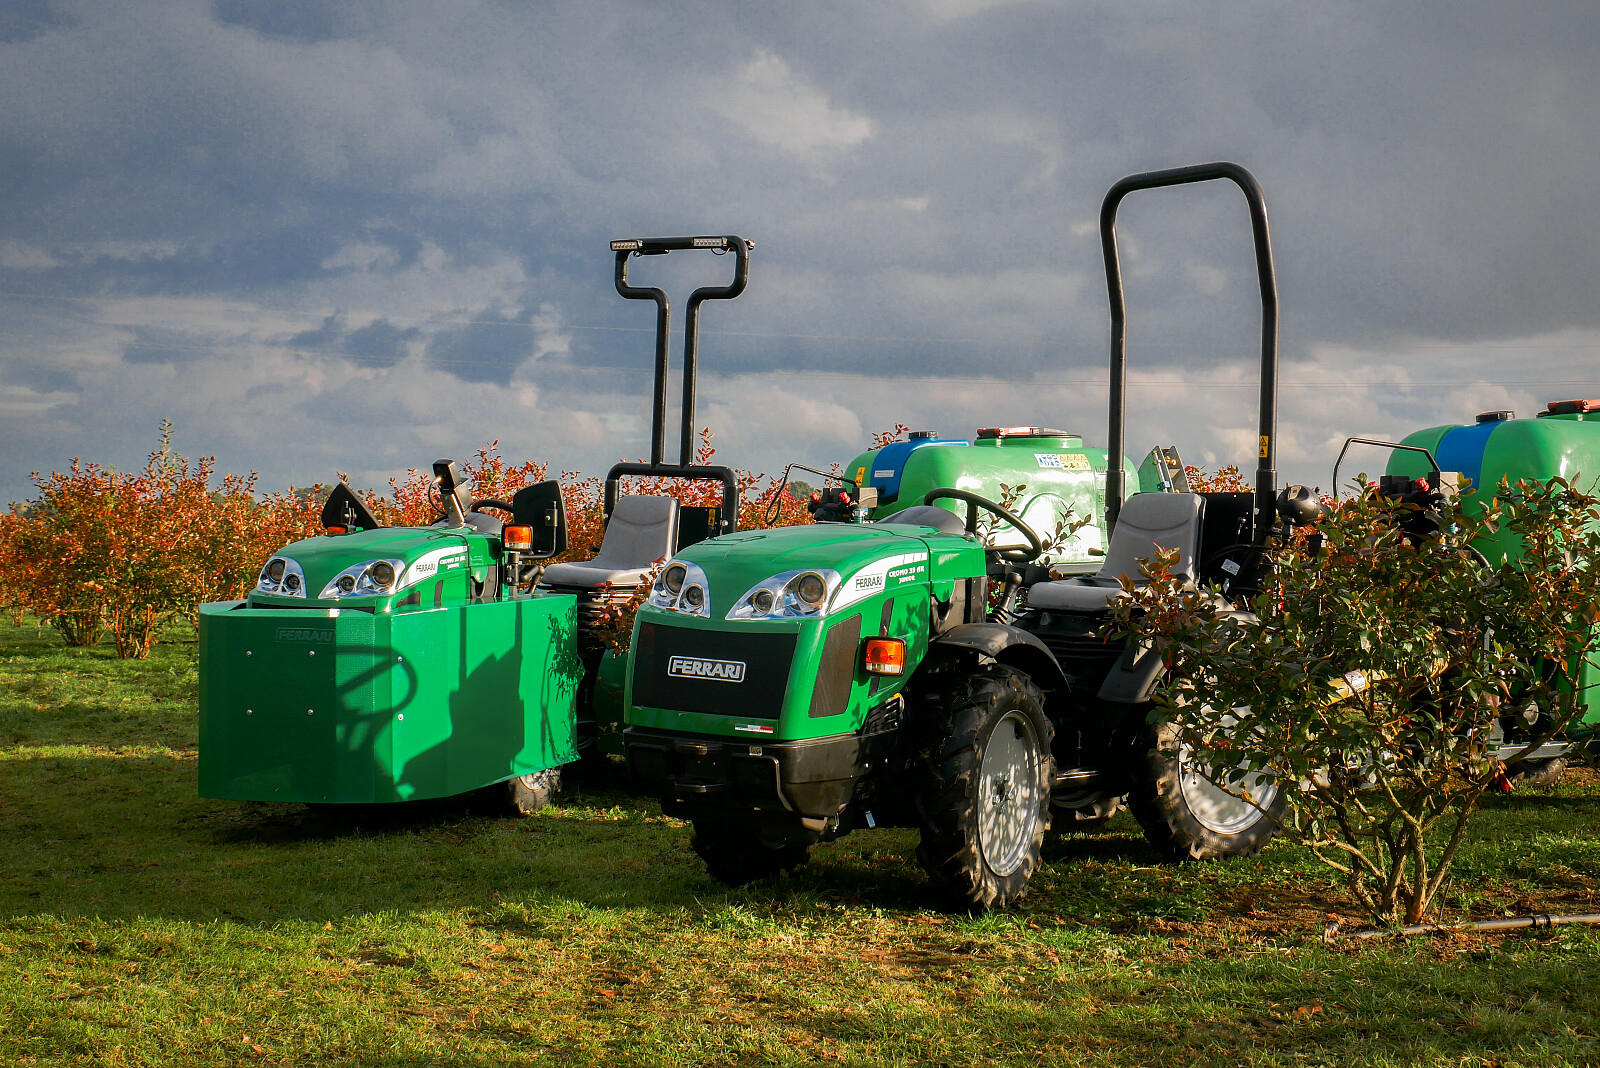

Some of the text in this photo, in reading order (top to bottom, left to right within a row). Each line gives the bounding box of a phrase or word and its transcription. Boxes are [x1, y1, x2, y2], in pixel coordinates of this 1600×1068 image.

[415, 563, 436, 573] FERRARI
[889, 568, 909, 578] CROMO
[855, 575, 883, 588] FERRARI
[279, 630, 333, 642] FERRARI
[672, 659, 741, 679] FERRARI
